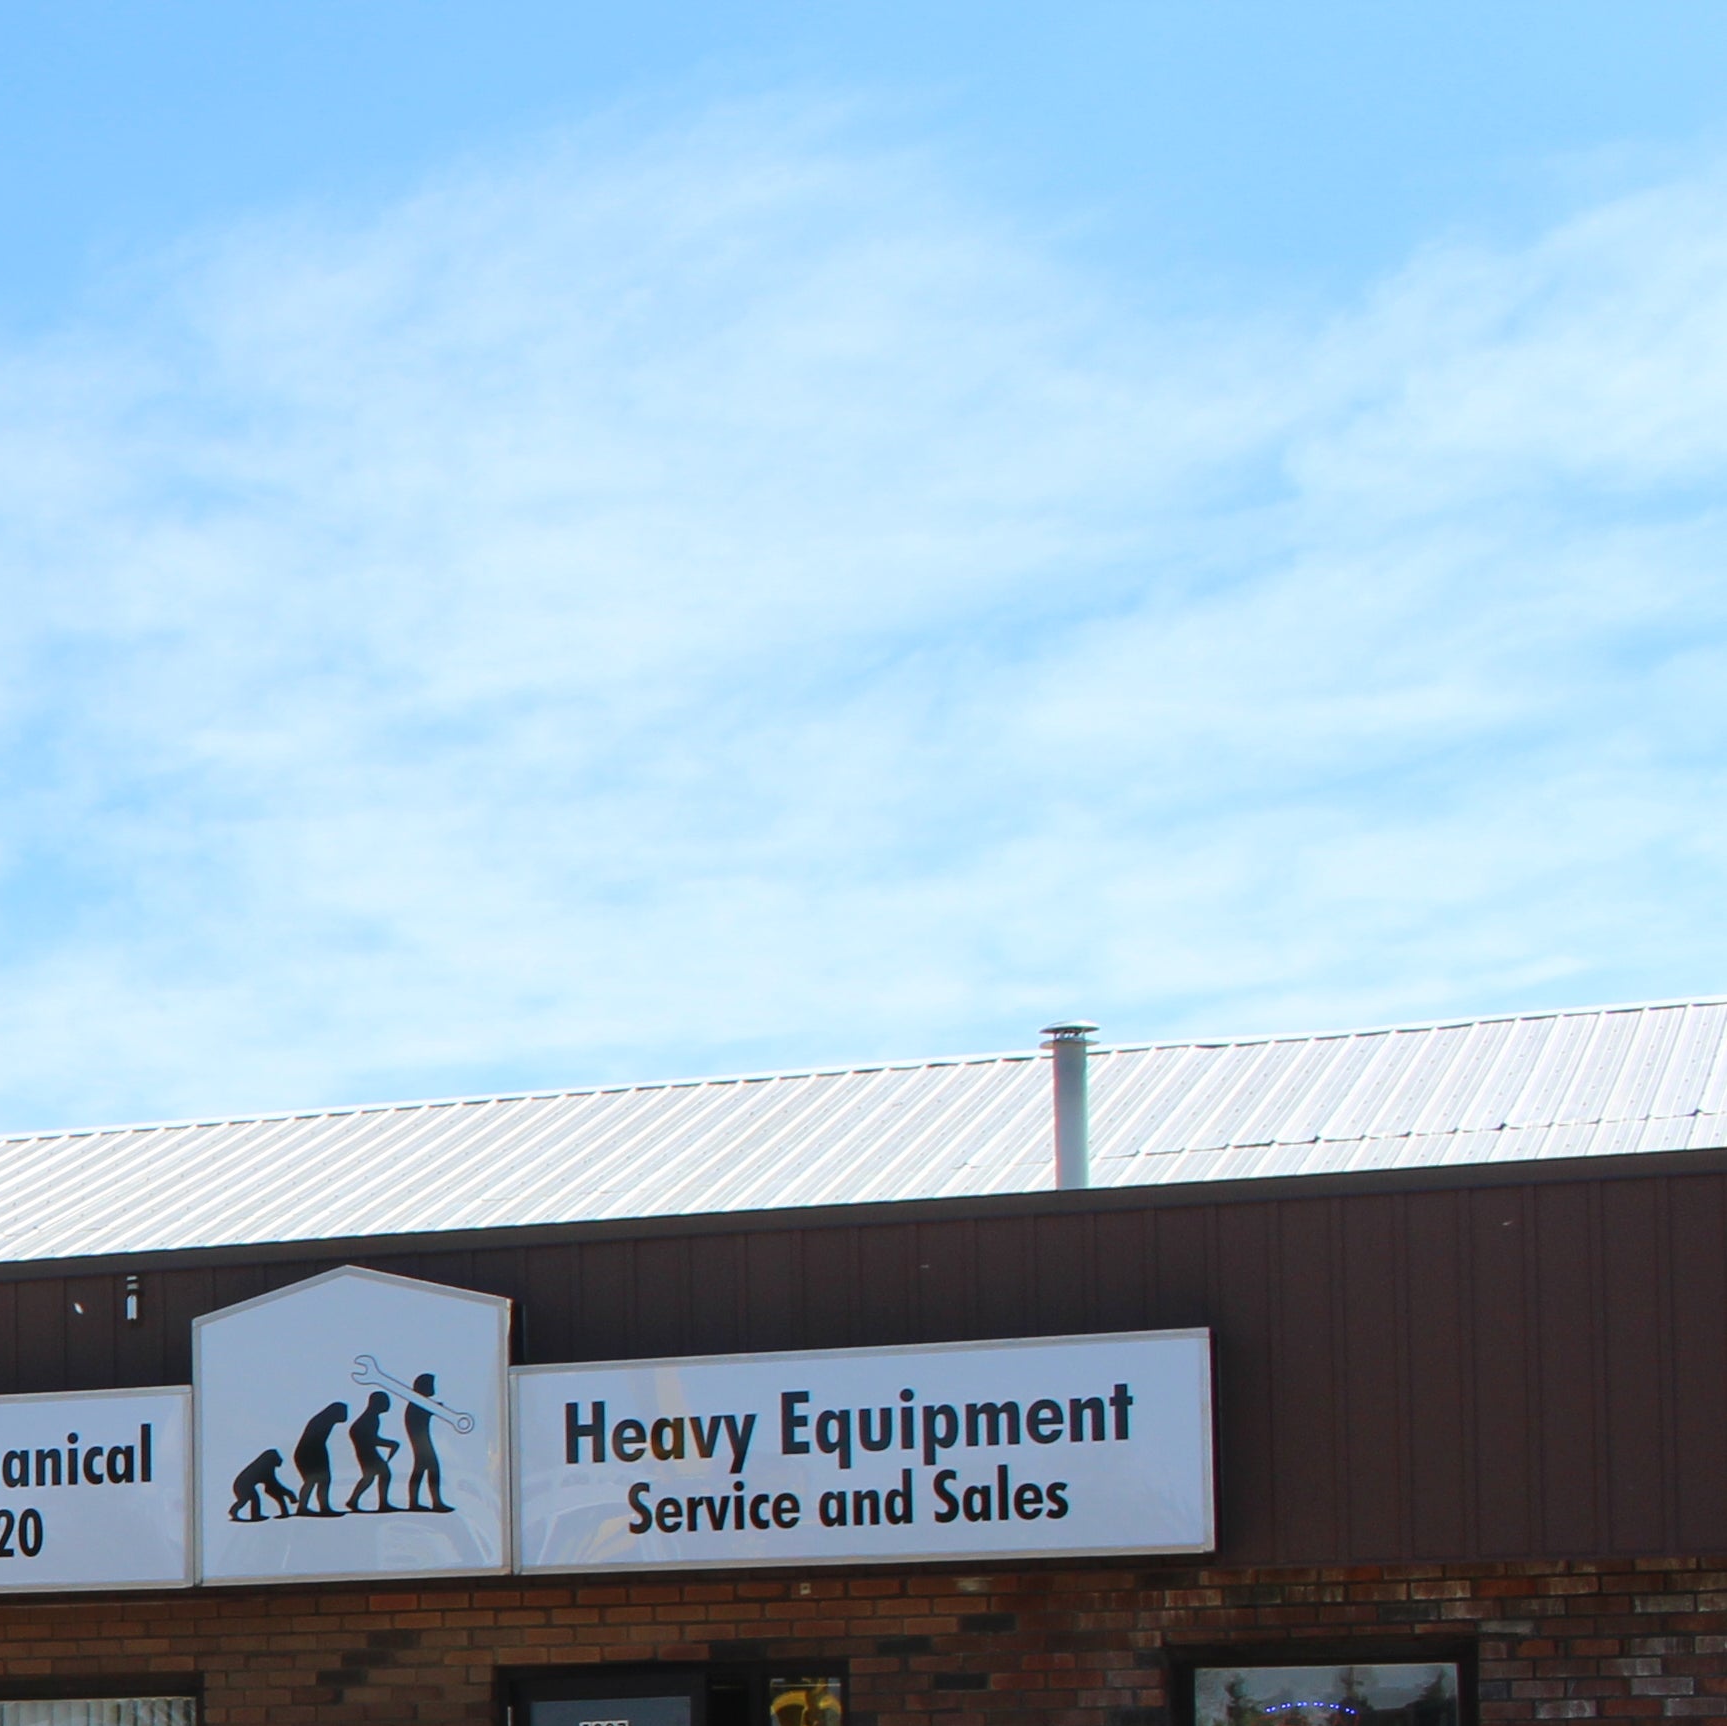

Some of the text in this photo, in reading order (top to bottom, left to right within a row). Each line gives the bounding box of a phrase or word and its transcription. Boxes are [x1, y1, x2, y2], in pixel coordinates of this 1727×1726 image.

[564, 1382, 1134, 1474] Heavy Equipment
[628, 1464, 1070, 1535] Service and Sales
